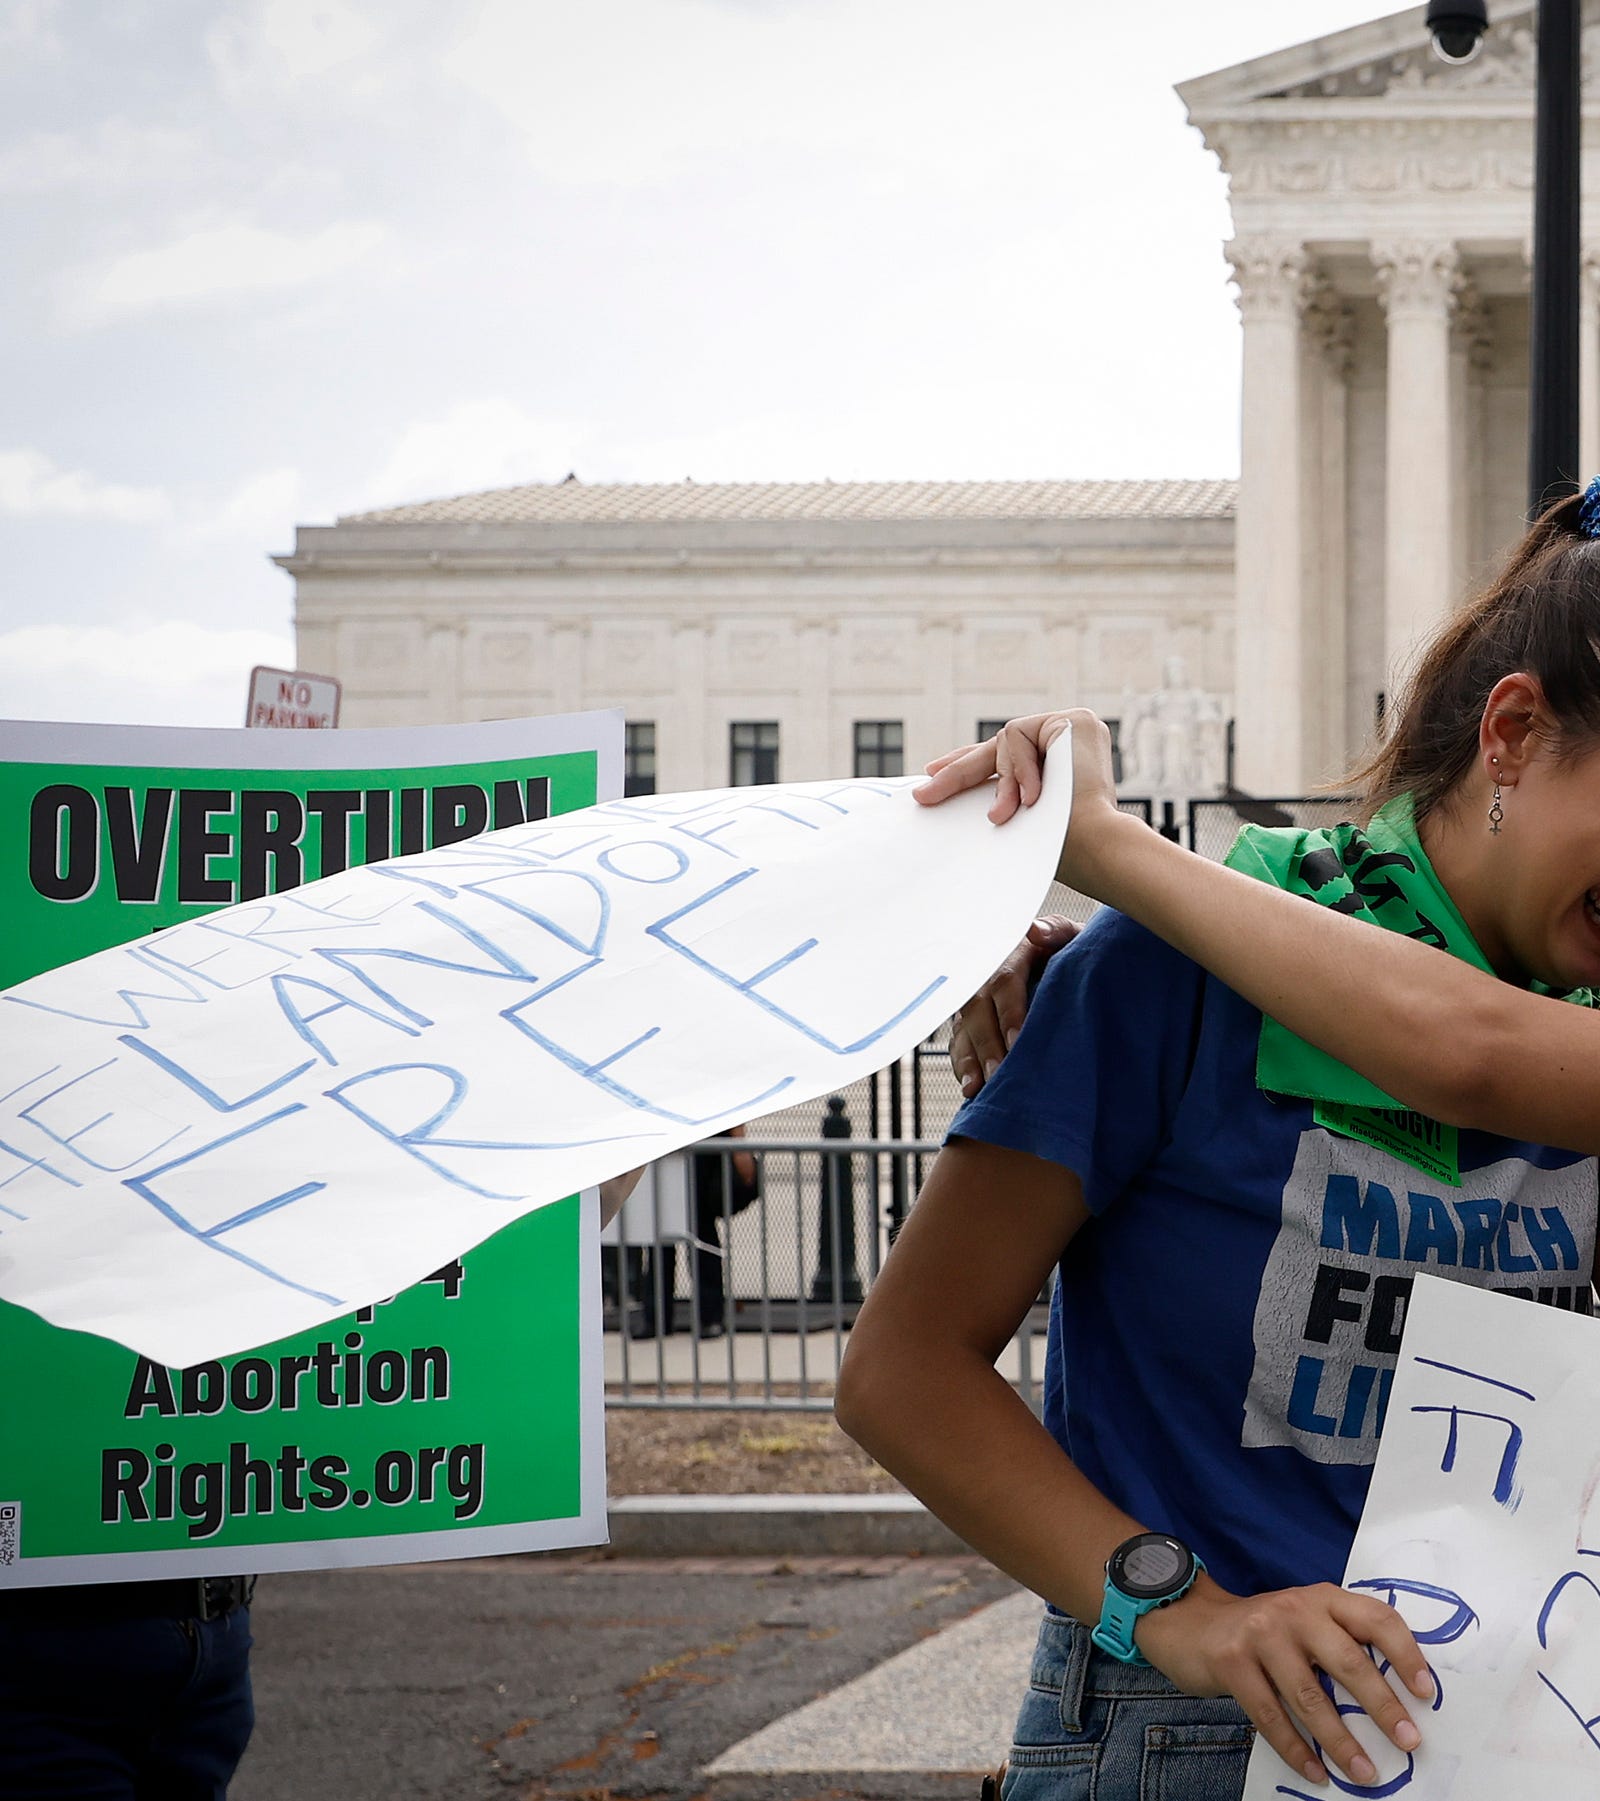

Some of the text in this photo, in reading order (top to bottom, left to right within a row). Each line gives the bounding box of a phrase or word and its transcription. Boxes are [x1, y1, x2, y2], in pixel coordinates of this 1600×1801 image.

[277, 679, 312, 708] NO
[28, 776, 550, 904] OVERTURN
[116, 867, 611, 1113] LAND
[120, 867, 949, 1307] FREE
[1320, 1174, 1580, 1273] MARCH
[1303, 1264, 1416, 1354] FO
[124, 1331, 449, 1419] Abortion
[1410, 1356, 1537, 1514] IF
[101, 1443, 484, 1539] Rights.org
